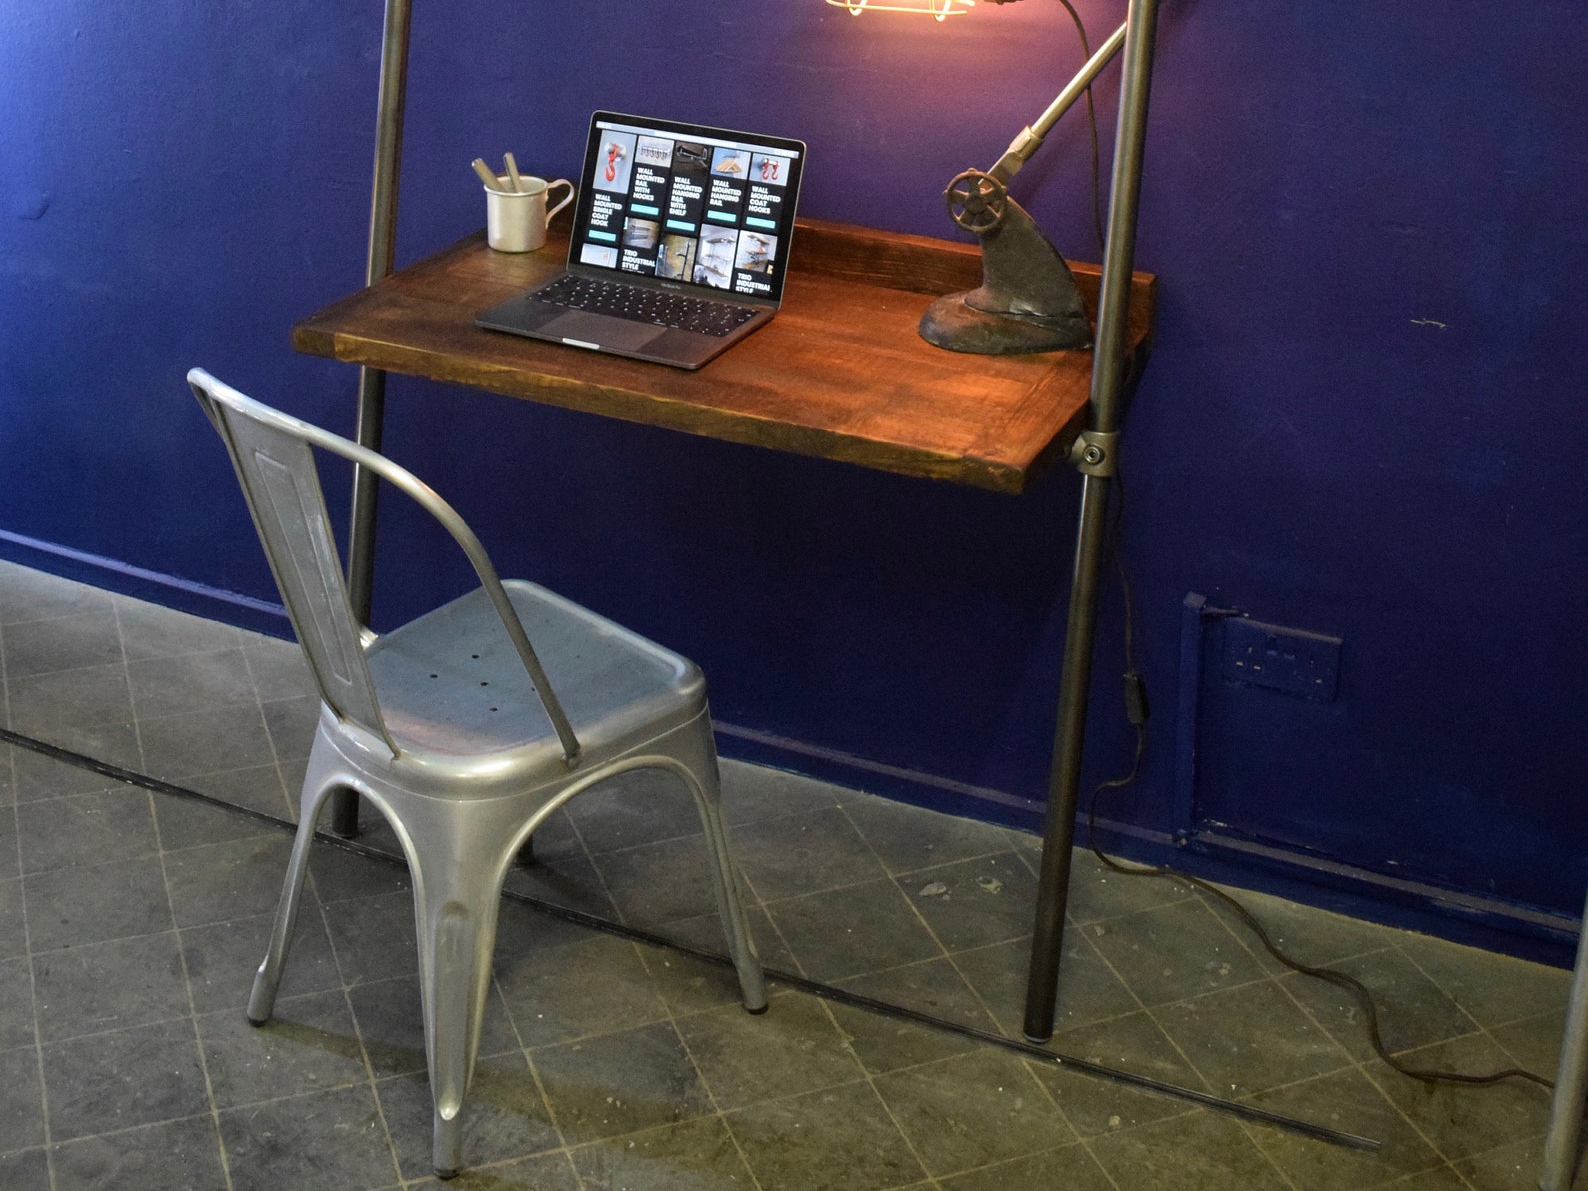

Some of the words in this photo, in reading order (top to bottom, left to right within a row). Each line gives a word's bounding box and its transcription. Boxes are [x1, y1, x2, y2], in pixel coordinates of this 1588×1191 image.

[638, 167, 653, 175] WALL
[636, 174, 665, 184] MOUNTED
[713, 179, 729, 187] WALL
[635, 180, 648, 188] RAIL
[673, 183, 702, 193] MOUNTED
[634, 186, 650, 194] WITH
[712, 186, 741, 196] MOUNTED
[752, 185, 768, 194] WALL
[595, 193, 611, 201] WALL
[633, 192, 654, 201] HOOKS
[672, 190, 700, 199] HANGING
[711, 193, 739, 202] HANGING
[751, 192, 781, 202] MOUNTED
[594, 200, 622, 210] MOUNTED
[670, 202, 686, 210] WITH
[750, 199, 767, 207] COAT
[749, 205, 771, 214] HOOKS
[591, 219, 608, 227] HOOK
[622, 261, 638, 270] STYLE
[623, 256, 655, 267] INDUSTRIAL
[738, 273, 752, 281] TRIO
